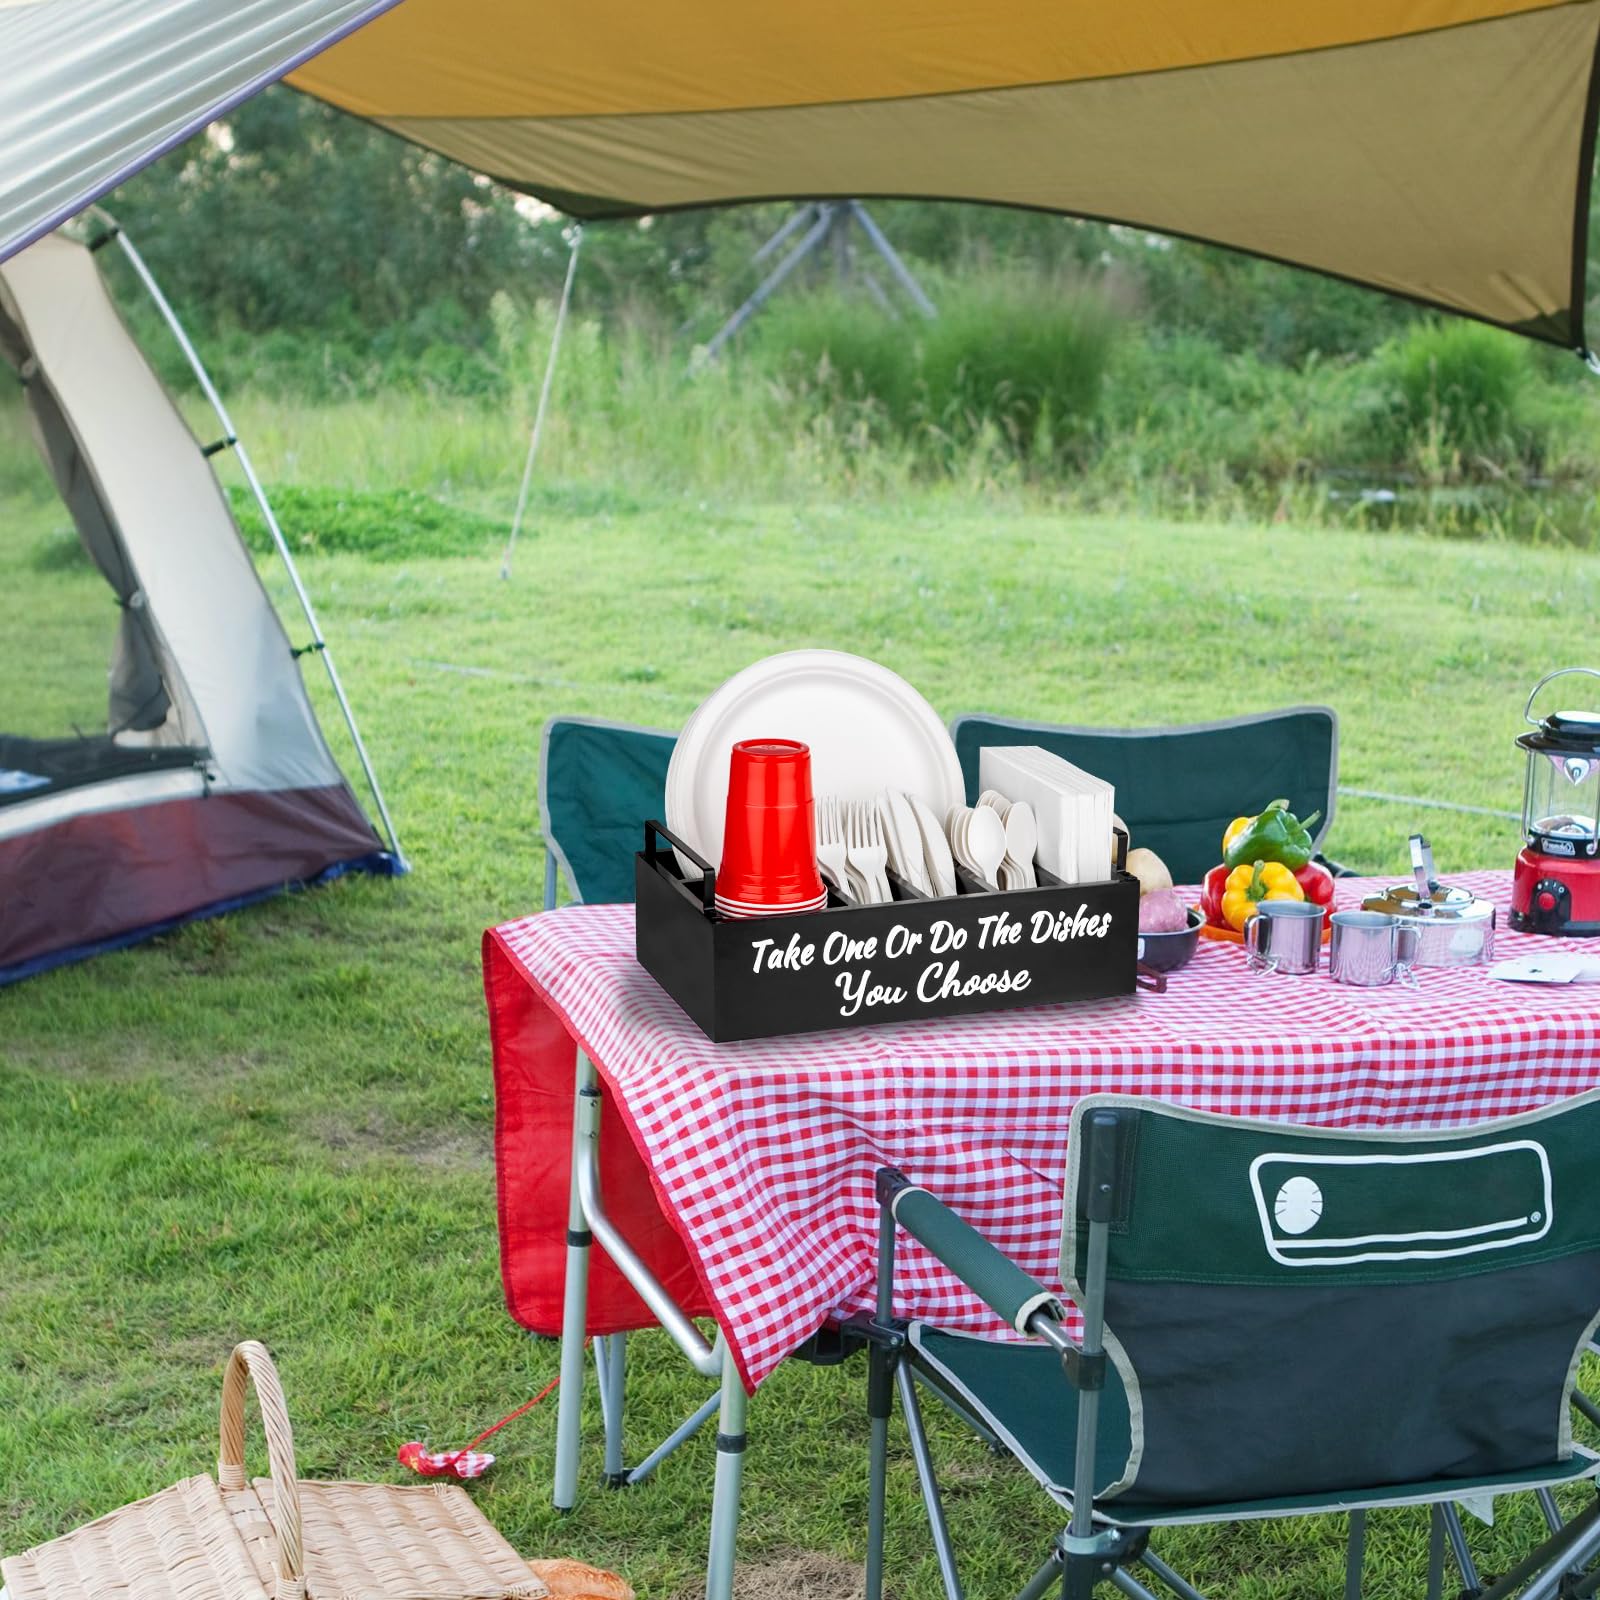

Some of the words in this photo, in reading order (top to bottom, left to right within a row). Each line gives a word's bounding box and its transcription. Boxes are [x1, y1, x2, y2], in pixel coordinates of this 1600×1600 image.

[752, 933, 815, 973] Take
[823, 931, 877, 965] One
[885, 925, 922, 958] Or
[930, 920, 967, 953] Do
[978, 911, 1022, 949] The
[1031, 903, 1112, 943] Dishes
[835, 970, 907, 1016] You
[917, 960, 1031, 1002] Choose
